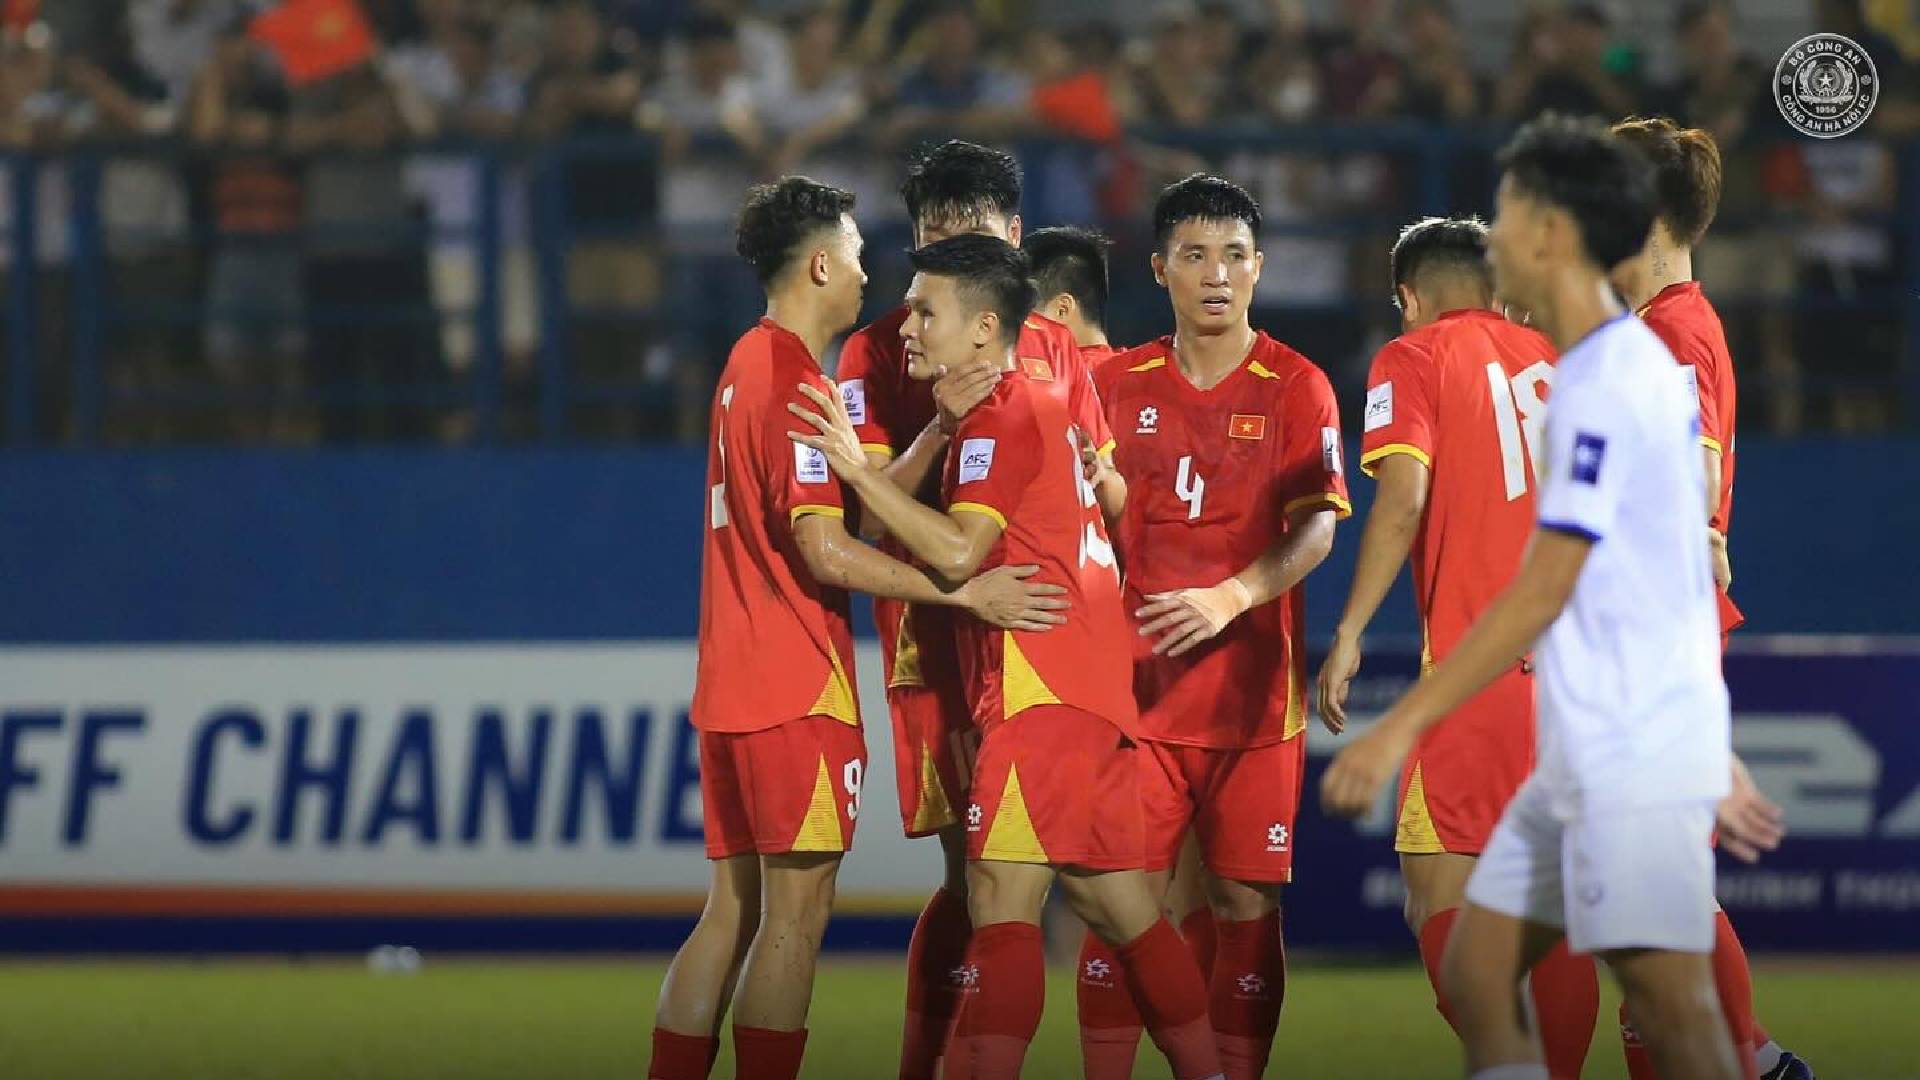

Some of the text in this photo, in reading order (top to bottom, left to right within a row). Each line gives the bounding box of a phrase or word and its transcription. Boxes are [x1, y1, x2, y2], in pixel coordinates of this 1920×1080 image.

[963, 453, 989, 465] AFC
[1175, 455, 1205, 520] 4
[843, 758, 862, 821] 9
